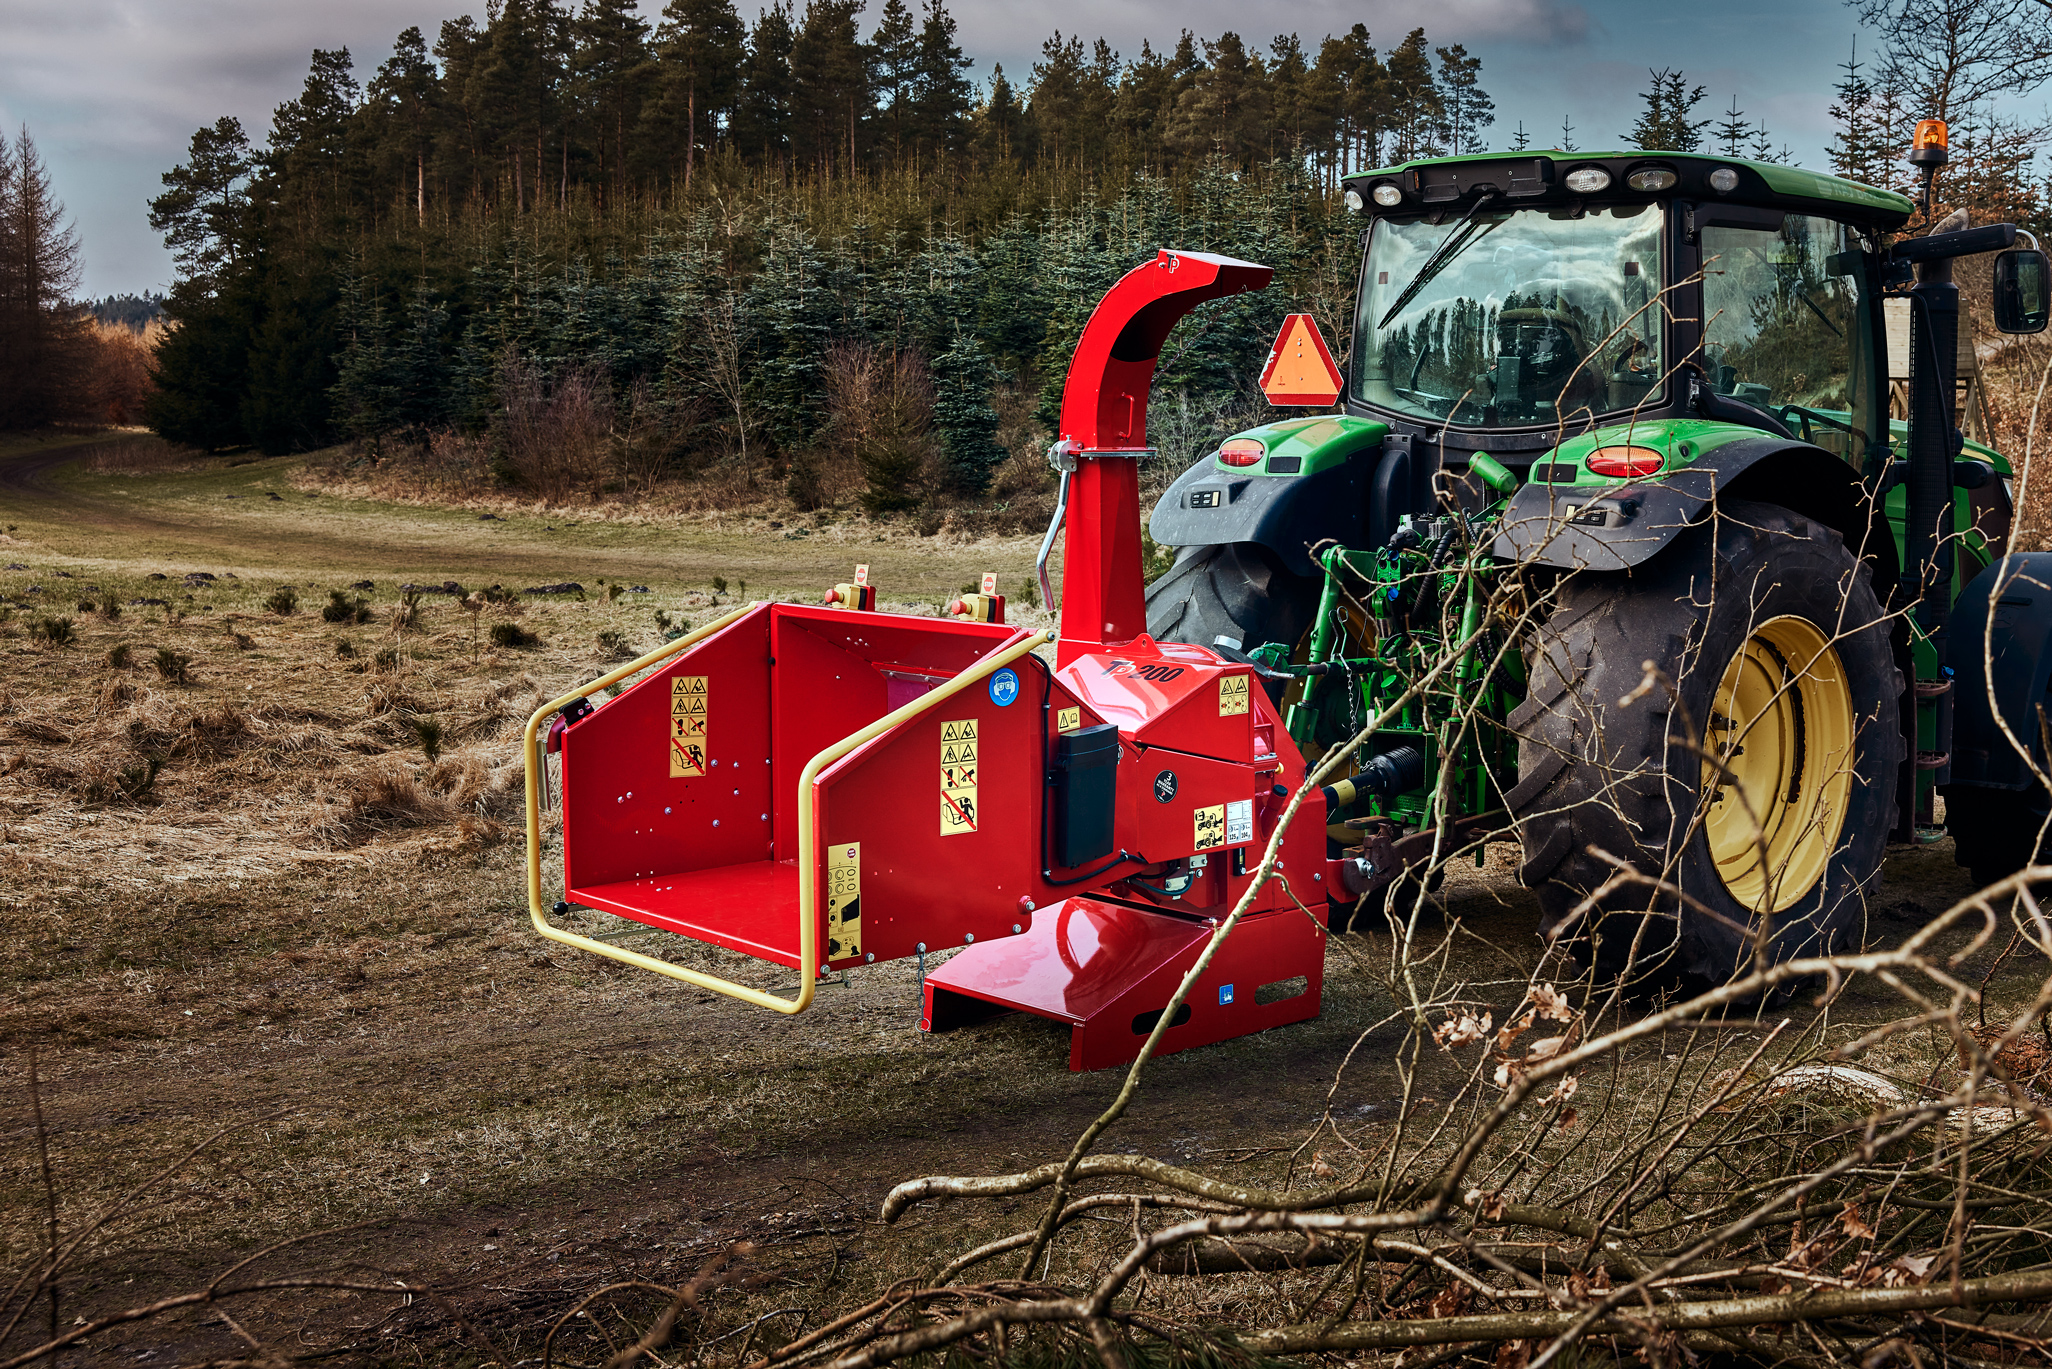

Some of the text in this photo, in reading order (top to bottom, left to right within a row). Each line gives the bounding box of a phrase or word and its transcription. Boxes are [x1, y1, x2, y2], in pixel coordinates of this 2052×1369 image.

[1166, 252, 1180, 274] TP
[1127, 664, 1185, 683] 200
[1166, 772, 1173, 781] 3
